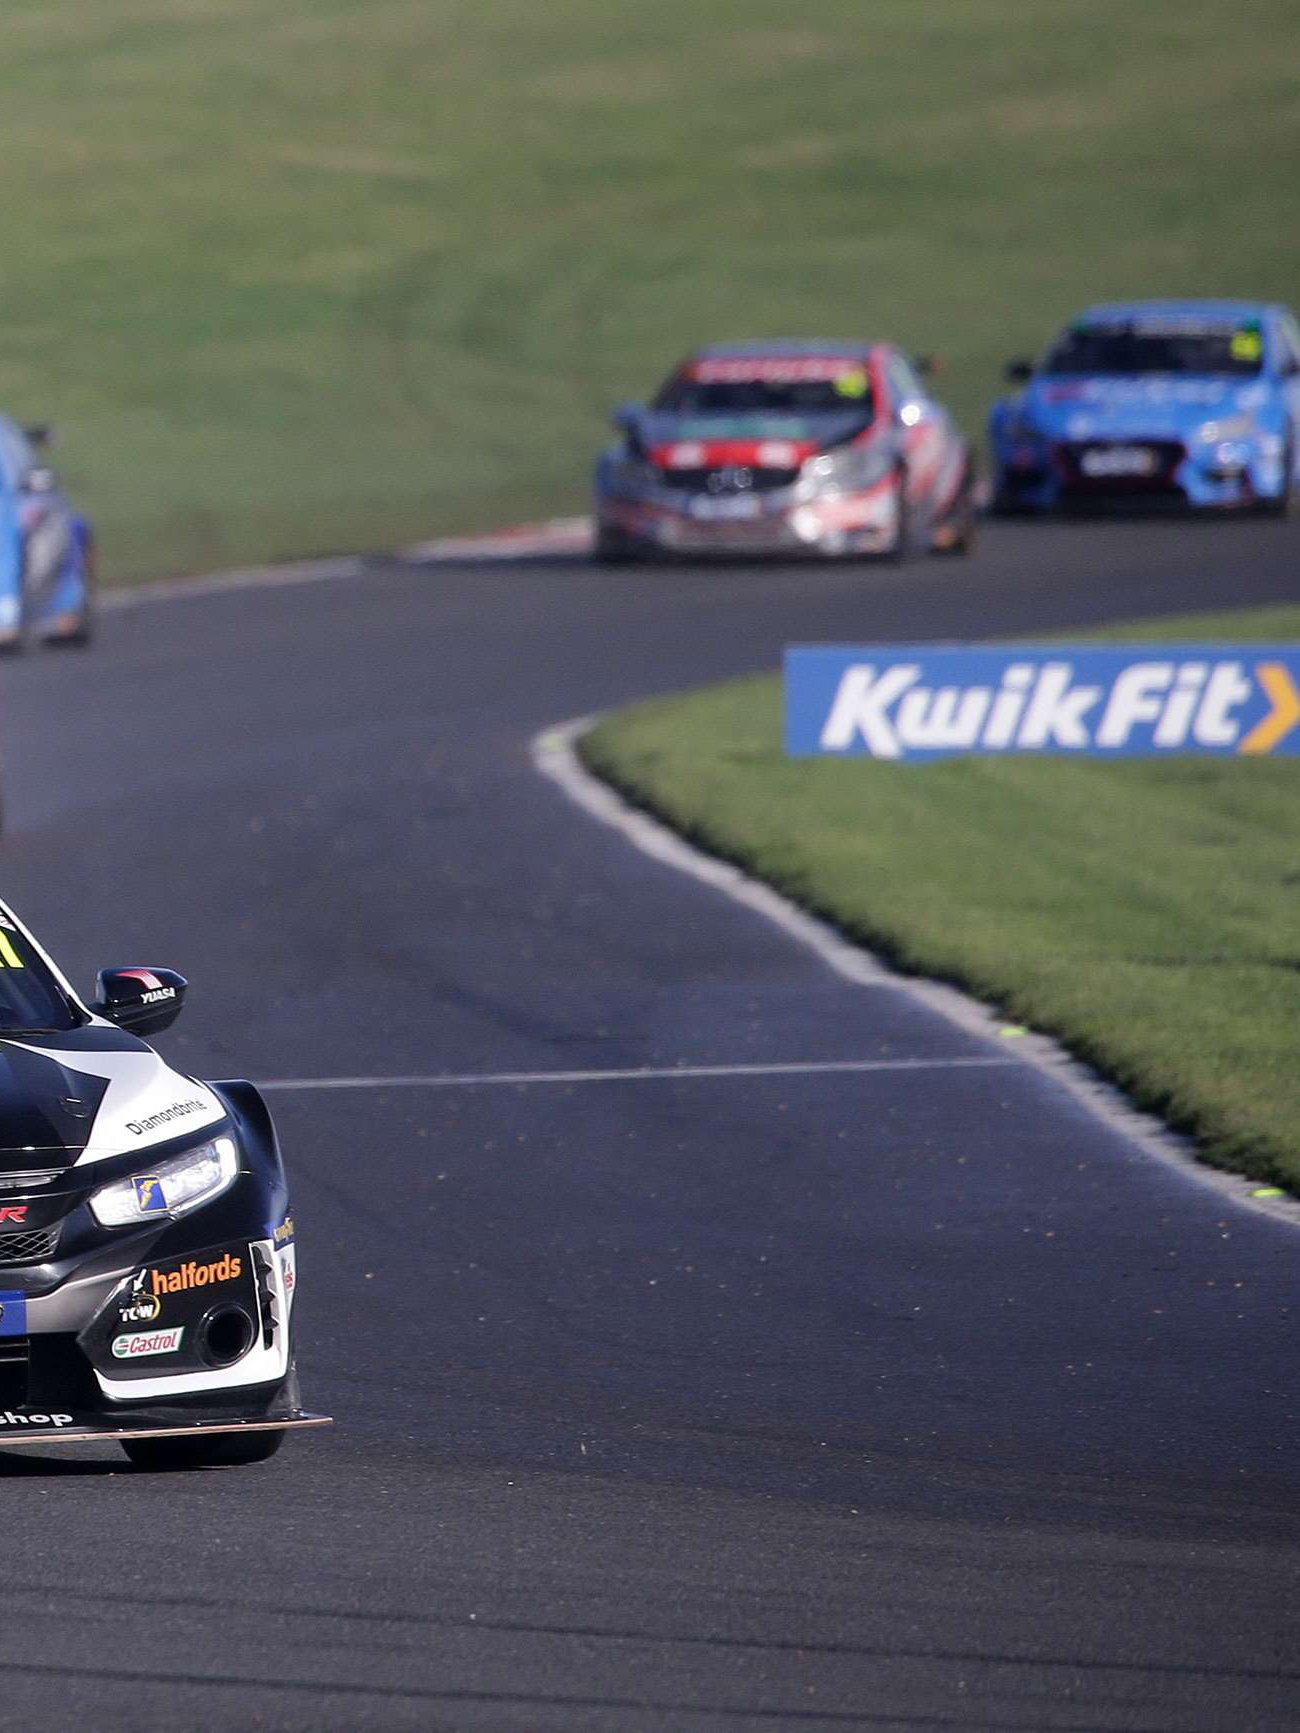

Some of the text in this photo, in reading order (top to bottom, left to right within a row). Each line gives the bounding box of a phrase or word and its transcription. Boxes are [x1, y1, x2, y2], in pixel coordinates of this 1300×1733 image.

[140, 987, 176, 1004] YUASA
[125, 1100, 207, 1136] Diamondbrite
[151, 1253, 242, 1296] halfords
[129, 1331, 178, 1354] Castrol
